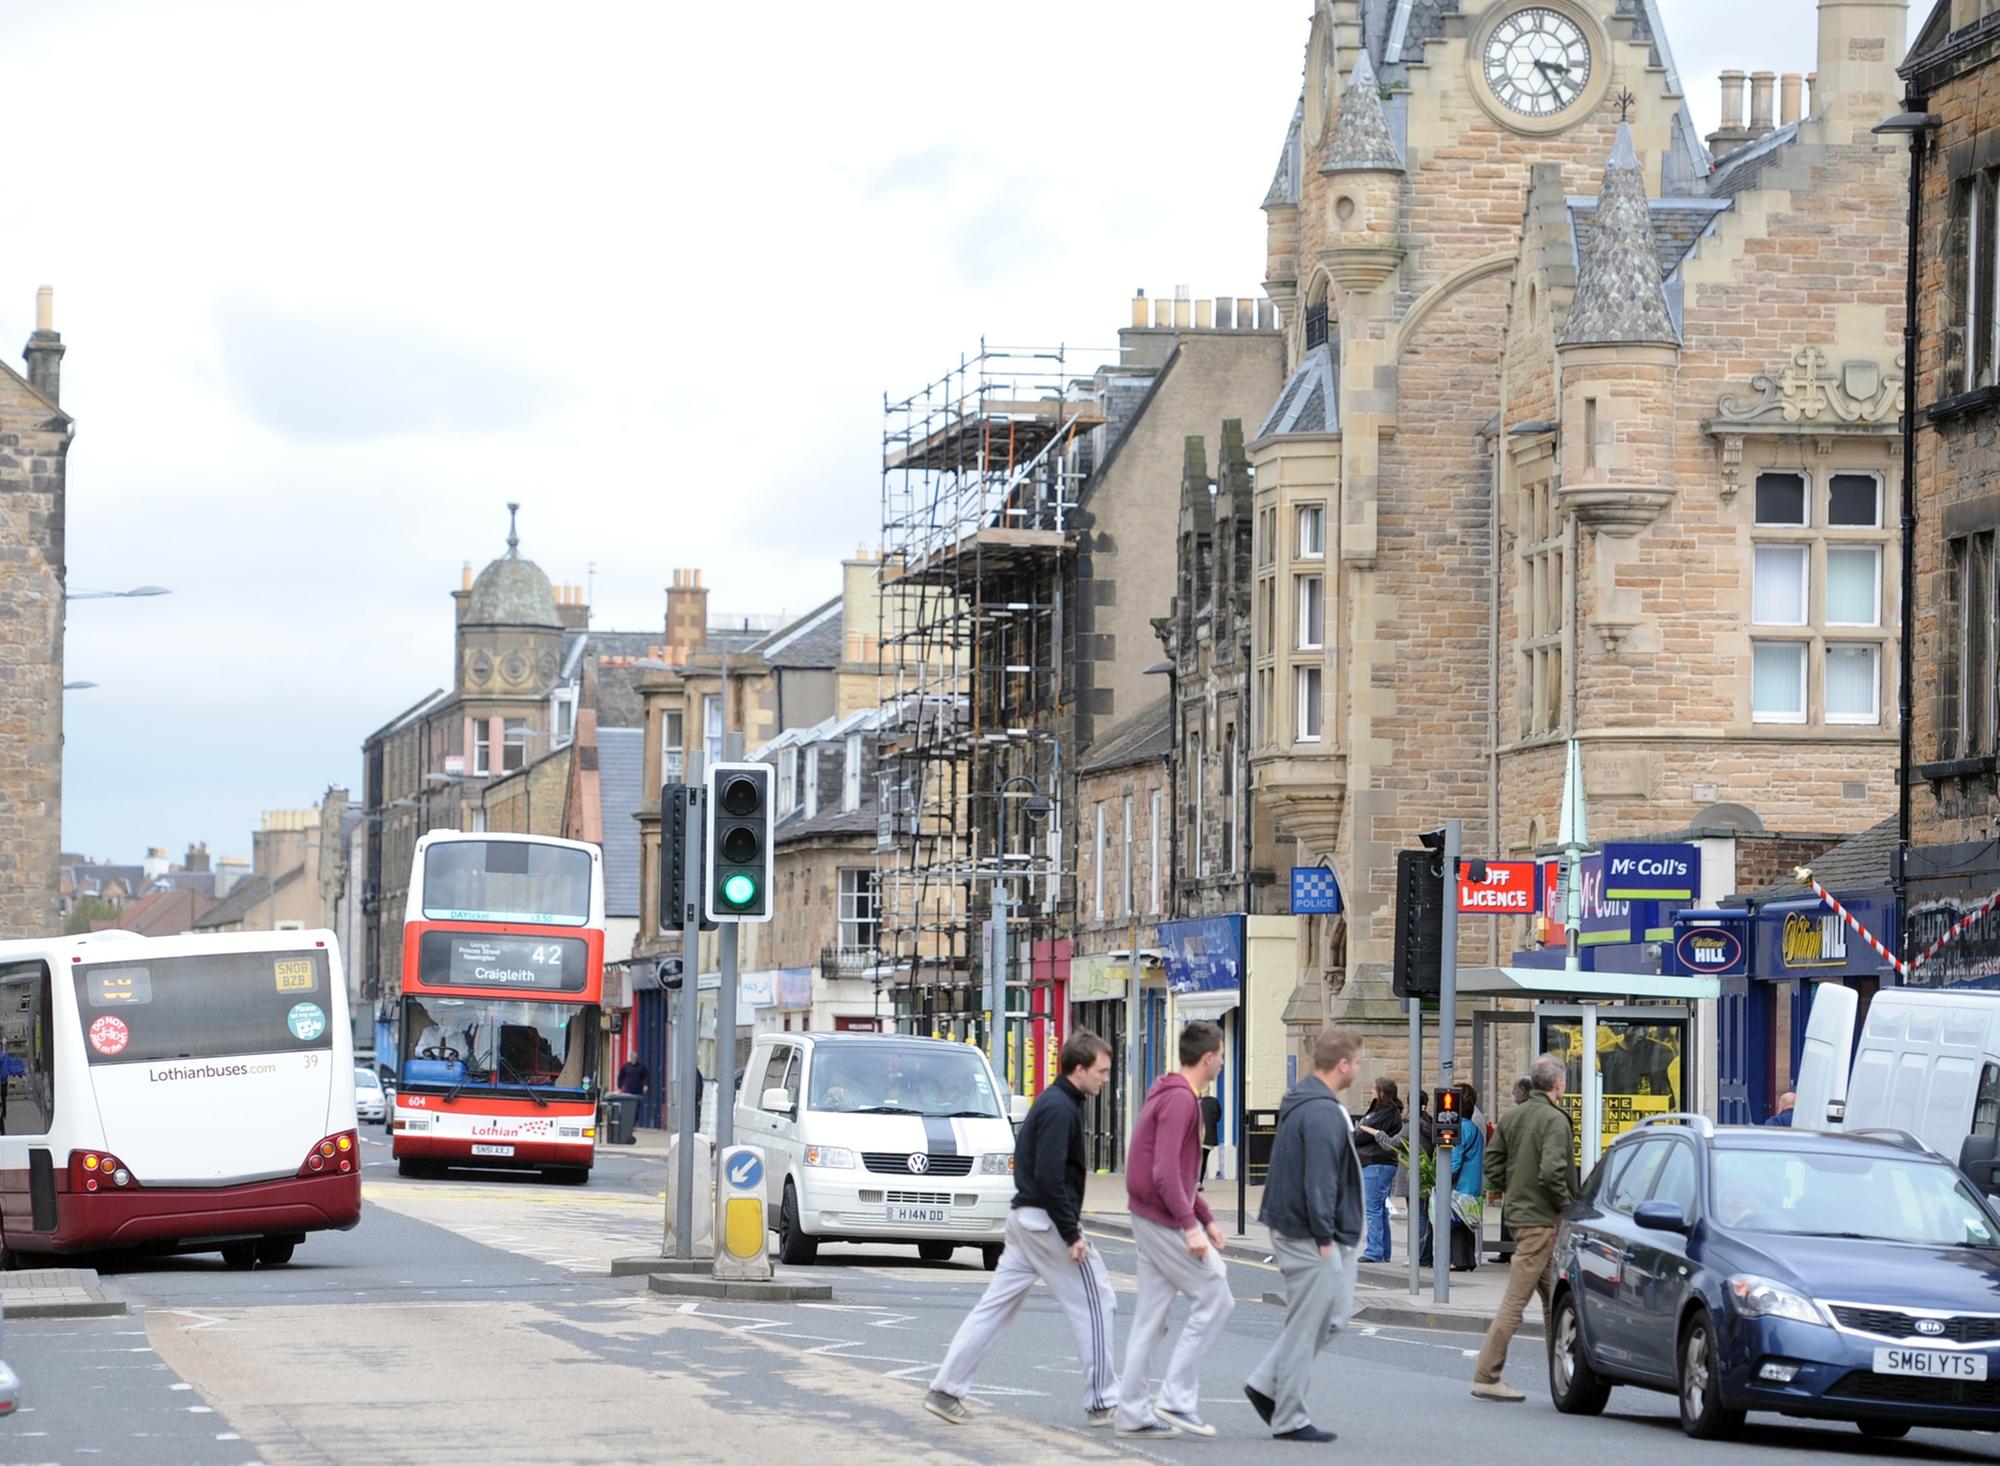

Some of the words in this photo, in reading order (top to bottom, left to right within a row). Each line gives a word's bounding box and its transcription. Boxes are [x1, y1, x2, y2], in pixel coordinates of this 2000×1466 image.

[1611, 859, 1687, 875] McColl's
[1296, 899, 1334, 908] POLICE
[1462, 886, 1527, 907] LICENCE
[1821, 915, 1847, 959] HILL
[532, 945, 561, 965] 42
[1695, 948, 1725, 963] HILL
[278, 962, 308, 974] SN08
[475, 967, 534, 982] Craigleith
[283, 975, 305, 986] BZB
[92, 1018, 105, 1031] DO
[105, 1016, 126, 1029] NOT
[304, 1055, 318, 1069] 39
[149, 1063, 276, 1082] Lothianbuses.com
[408, 1096, 426, 1106] 604
[1602, 1098, 1631, 1107] HE
[472, 1127, 518, 1137] Lothian
[1920, 1323, 1940, 1332] KIA
[1888, 1351, 1931, 1372] SM61
[1938, 1355, 1975, 1375] YTS
